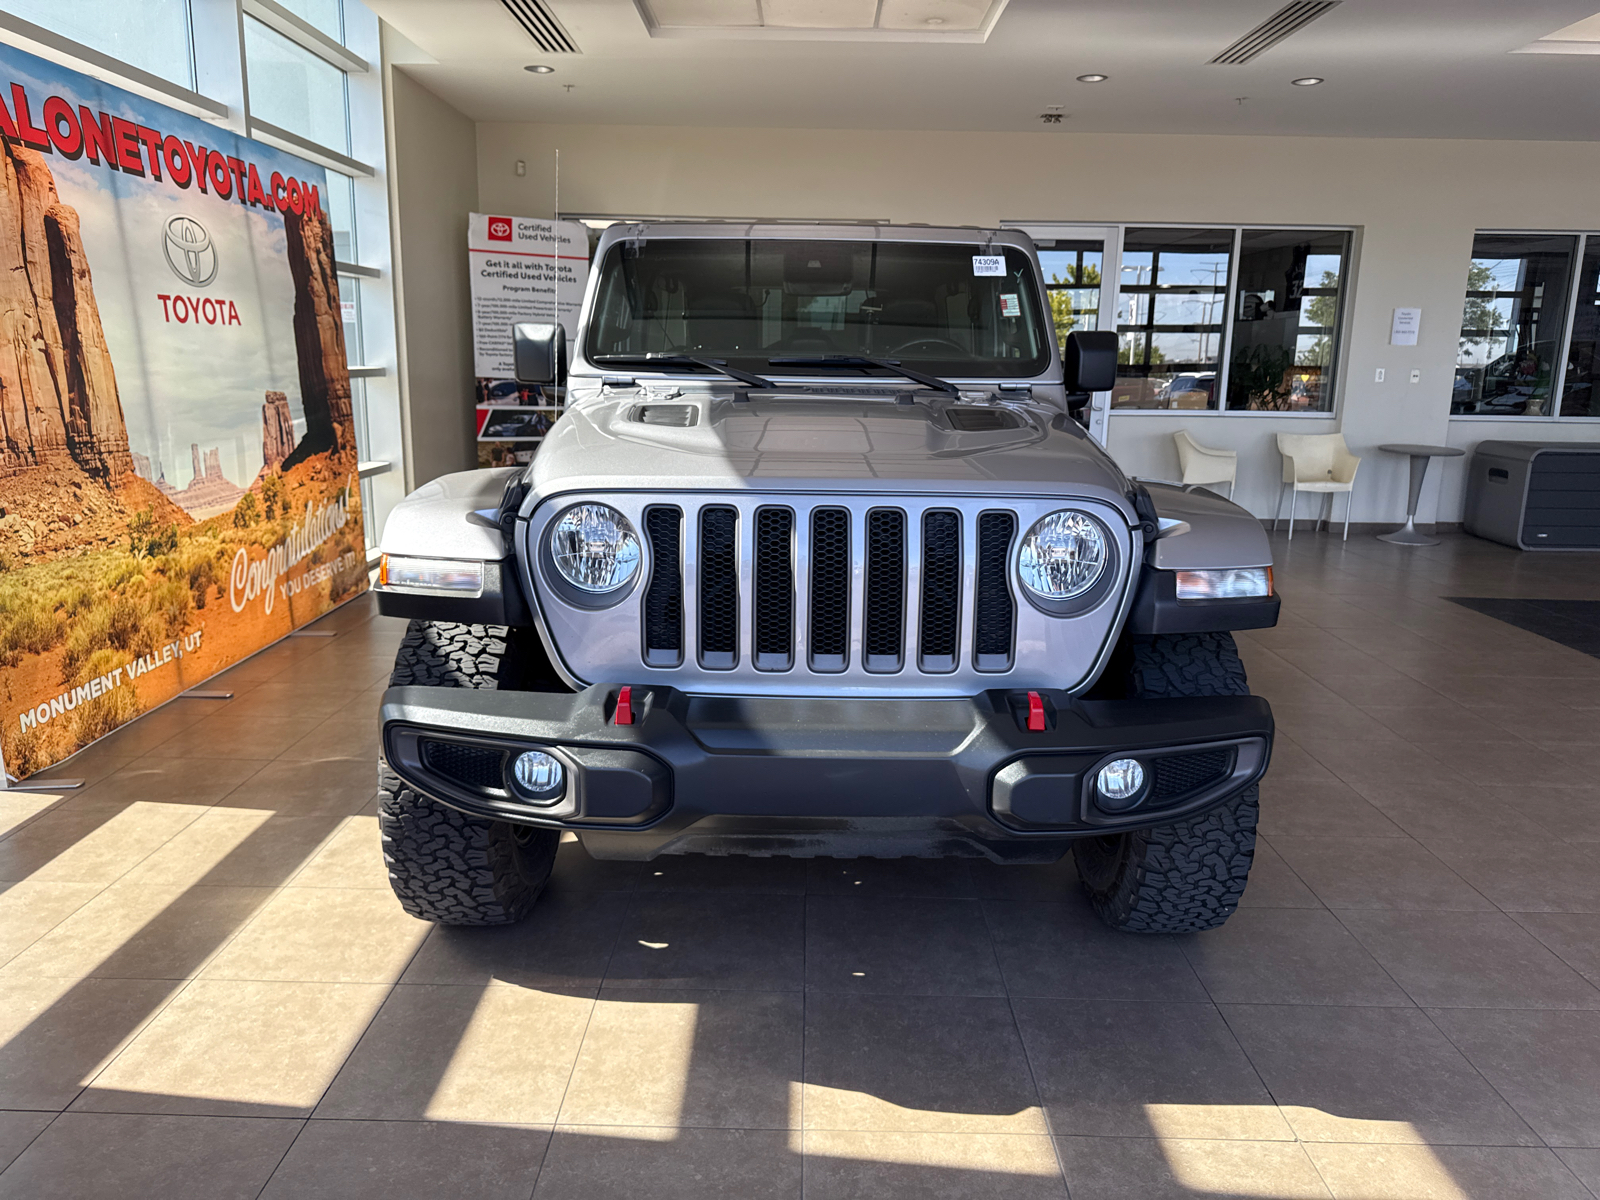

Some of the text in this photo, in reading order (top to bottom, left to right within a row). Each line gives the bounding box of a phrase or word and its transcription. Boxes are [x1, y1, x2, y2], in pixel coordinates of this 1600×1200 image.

[518, 223, 552, 233] Certified
[518, 233, 538, 241] Used
[486, 260, 502, 268] Get
[512, 261, 523, 269] all
[525, 263, 543, 271] with
[545, 263, 572, 273] Toyota
[974, 258, 1000, 266] 74309A
[481, 269, 577, 284] Certified Used Vehicles
[503, 285, 531, 295] Program
[157, 294, 242, 326] TOYOTA
[230, 473, 352, 615] Congratulations!
[279, 551, 356, 600] YOU DESERVE IT!
[19, 631, 202, 734] MONUMENT VALLEY, UT
